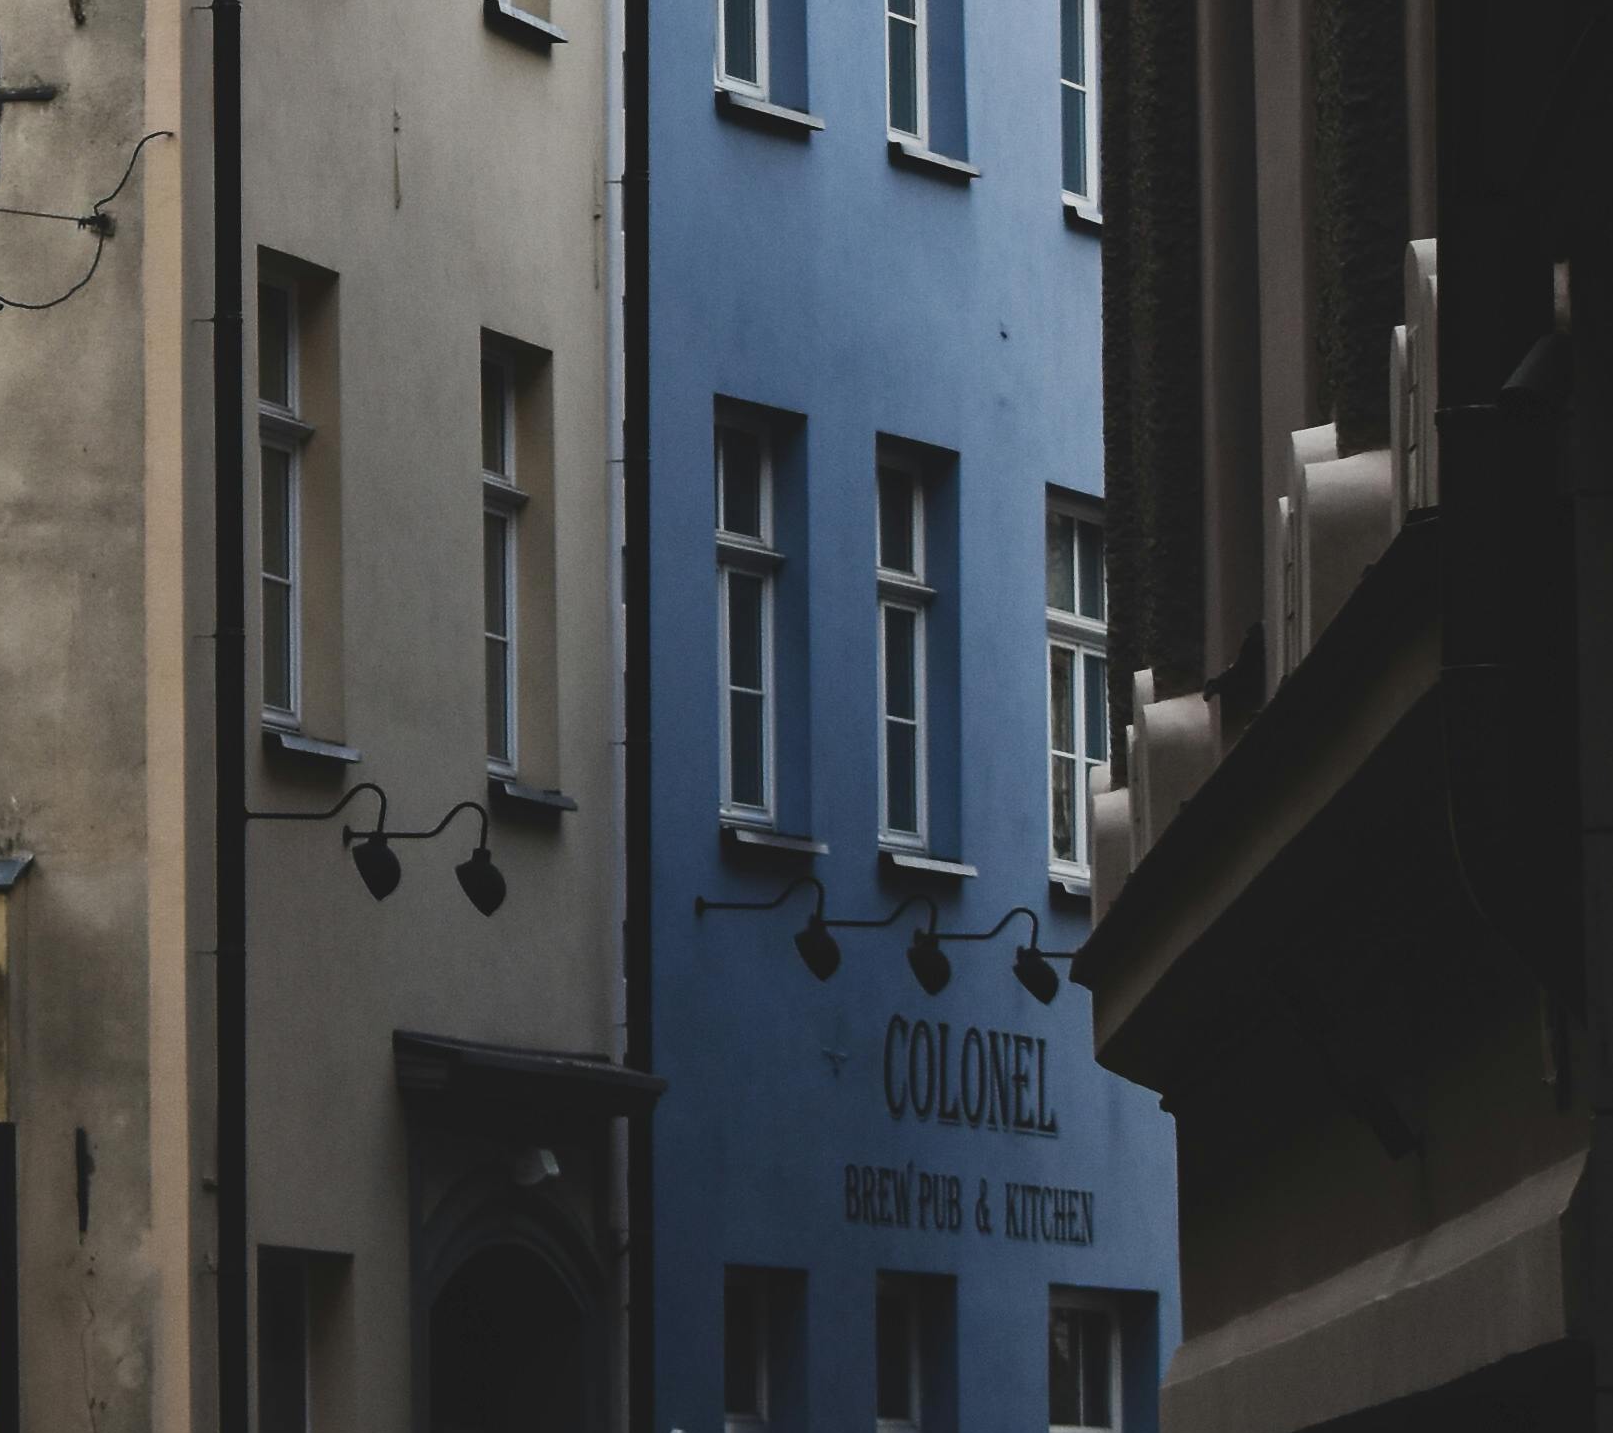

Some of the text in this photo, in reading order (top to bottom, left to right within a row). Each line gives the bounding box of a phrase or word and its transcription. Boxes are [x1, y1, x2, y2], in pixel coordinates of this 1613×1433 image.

[884, 1014, 1058, 1135] COLONEL
[919, 1172, 962, 1233] PUB
[975, 1178, 991, 1234] &
[1004, 1182, 1094, 1245] KITCHEN
